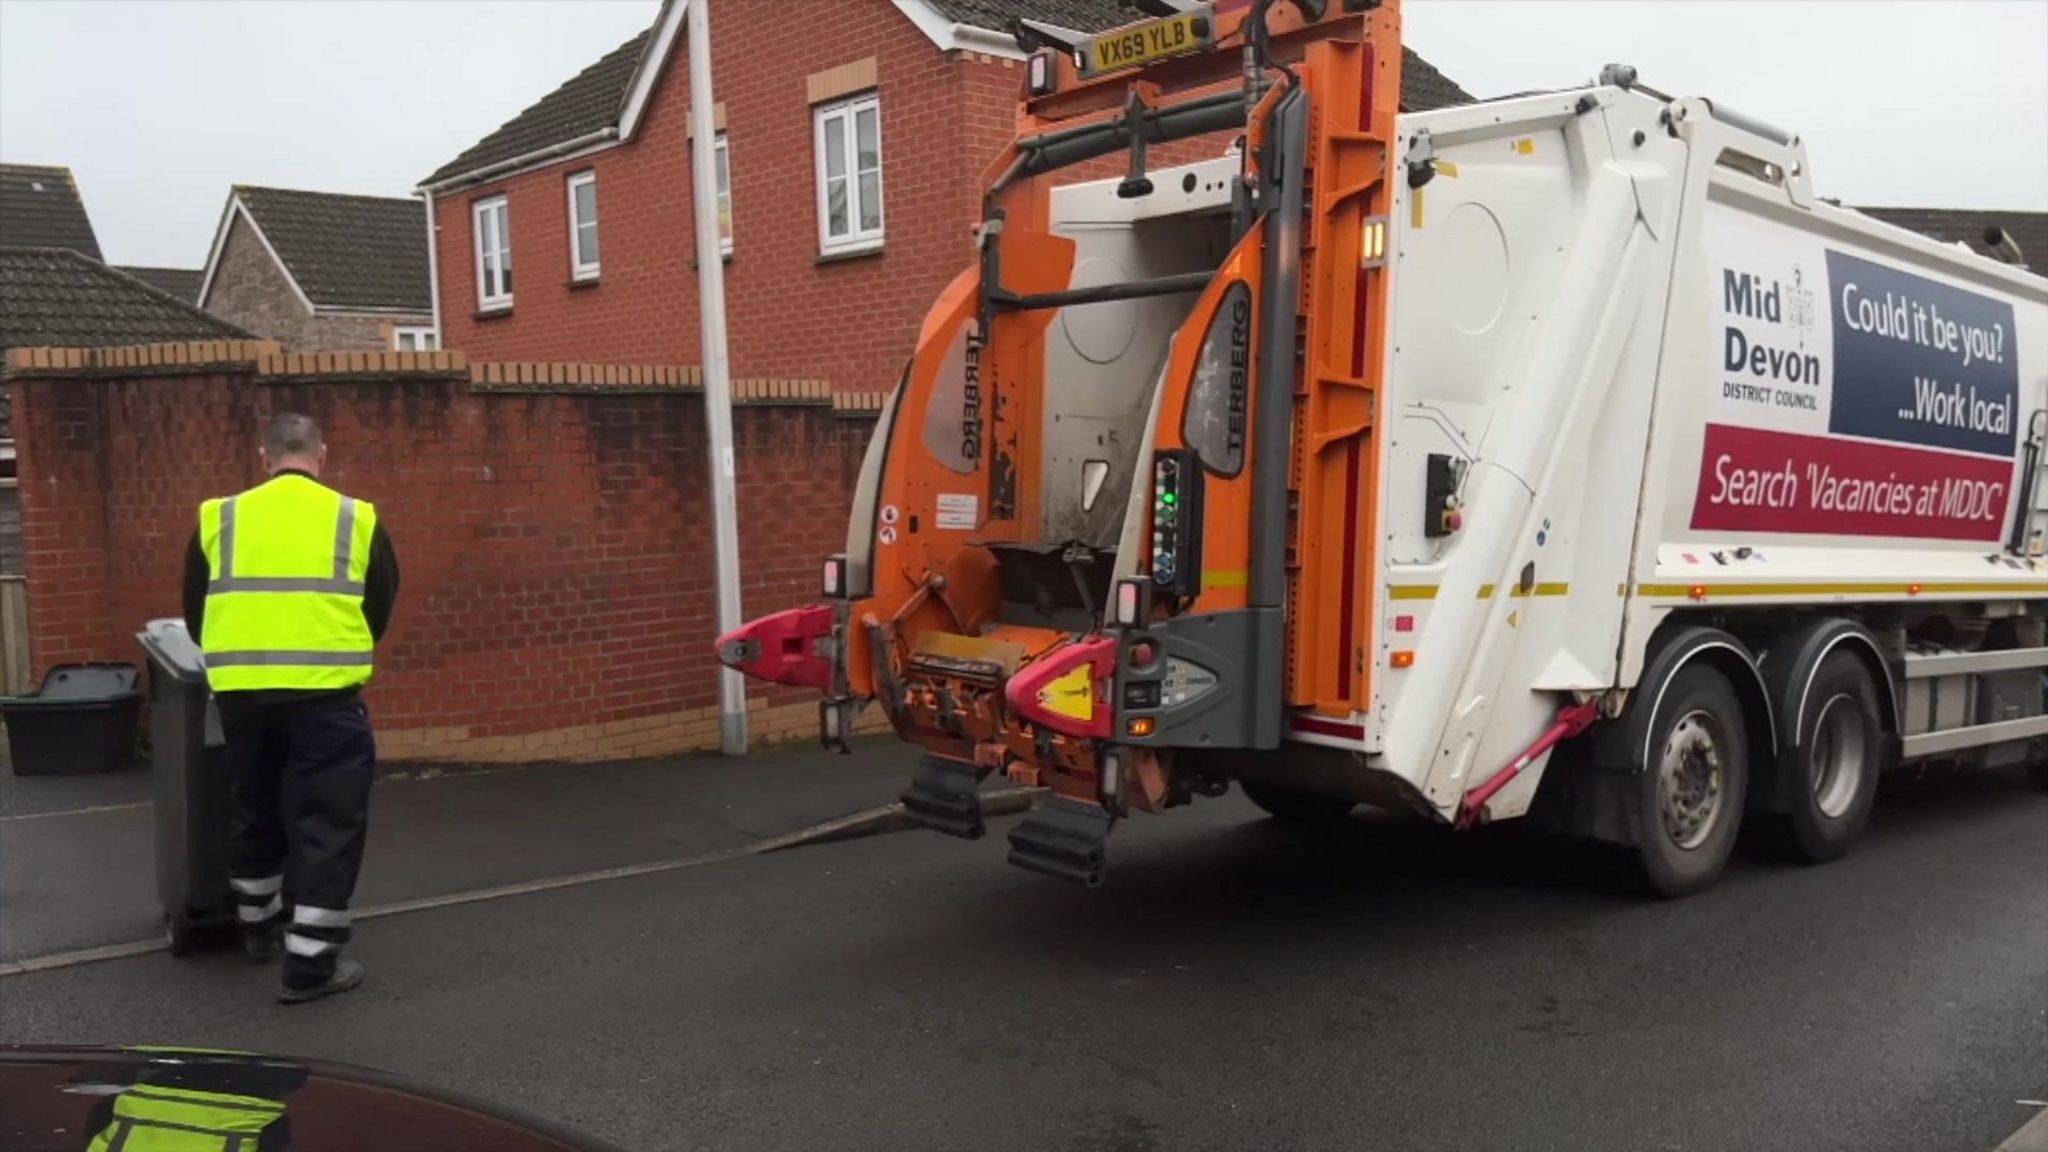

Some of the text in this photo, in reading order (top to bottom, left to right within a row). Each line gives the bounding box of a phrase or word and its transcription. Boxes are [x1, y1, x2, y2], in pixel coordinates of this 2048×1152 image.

[1100, 21, 1184, 64] VX69 YLB
[1723, 268, 1781, 323] Mid
[1842, 283, 2004, 366] Could it be you?
[1227, 300, 1246, 454] TERBERG
[1724, 327, 1820, 386] Devon
[1723, 383, 1817, 411] DISTRICT COUNCIL
[1898, 376, 2010, 435] ...Work local
[1710, 454, 2004, 521] Search 'Vacancies at MDDC'
